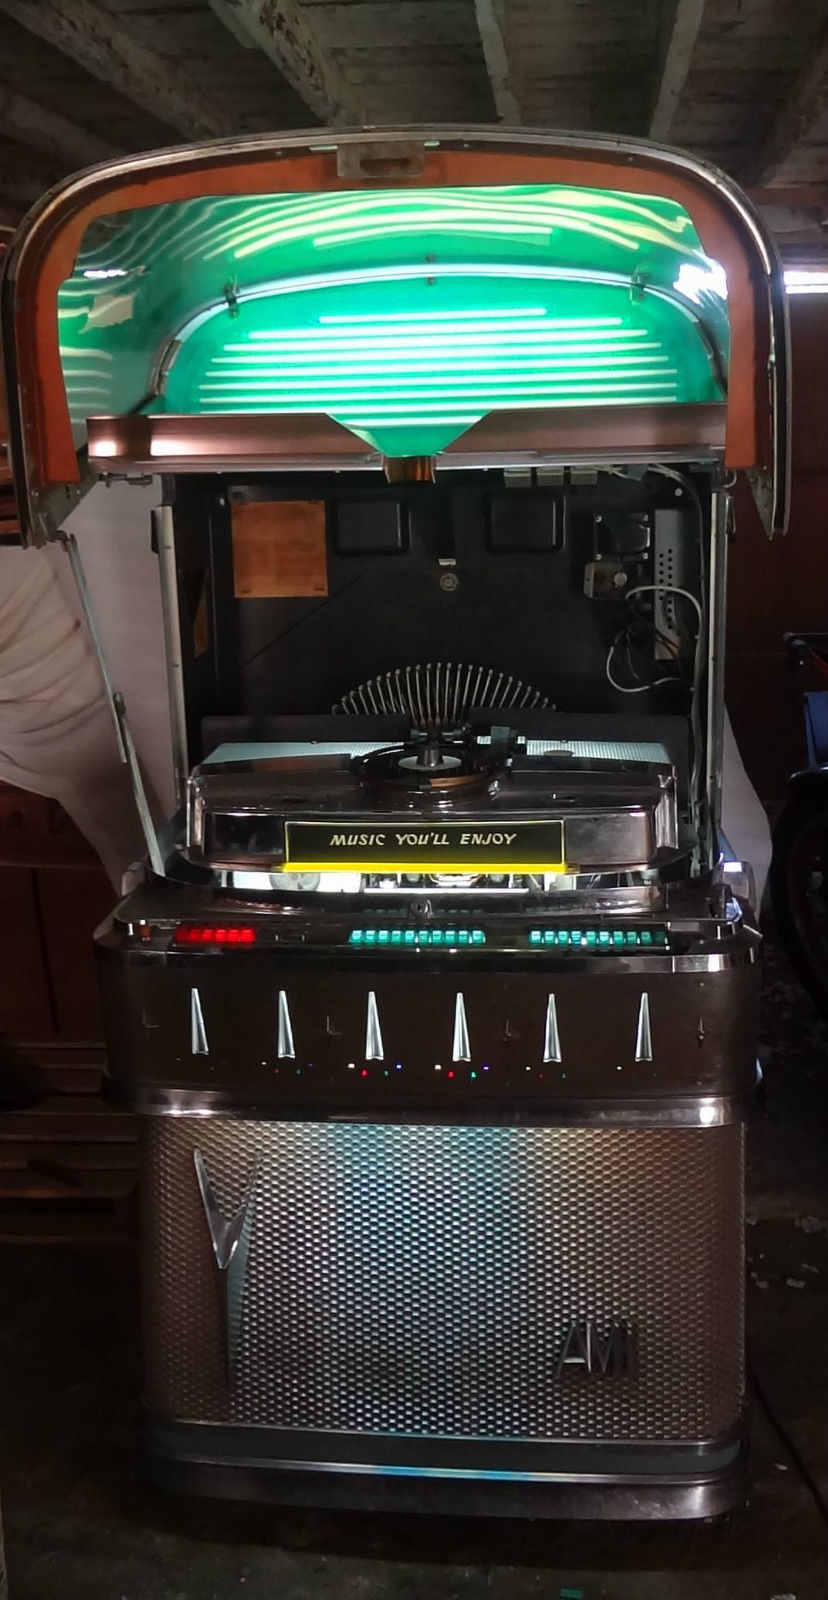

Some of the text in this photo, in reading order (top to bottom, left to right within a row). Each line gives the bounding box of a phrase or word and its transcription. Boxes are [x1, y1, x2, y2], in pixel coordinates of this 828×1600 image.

[329, 832, 517, 846] MUSIC YOU'LL ENJOY
